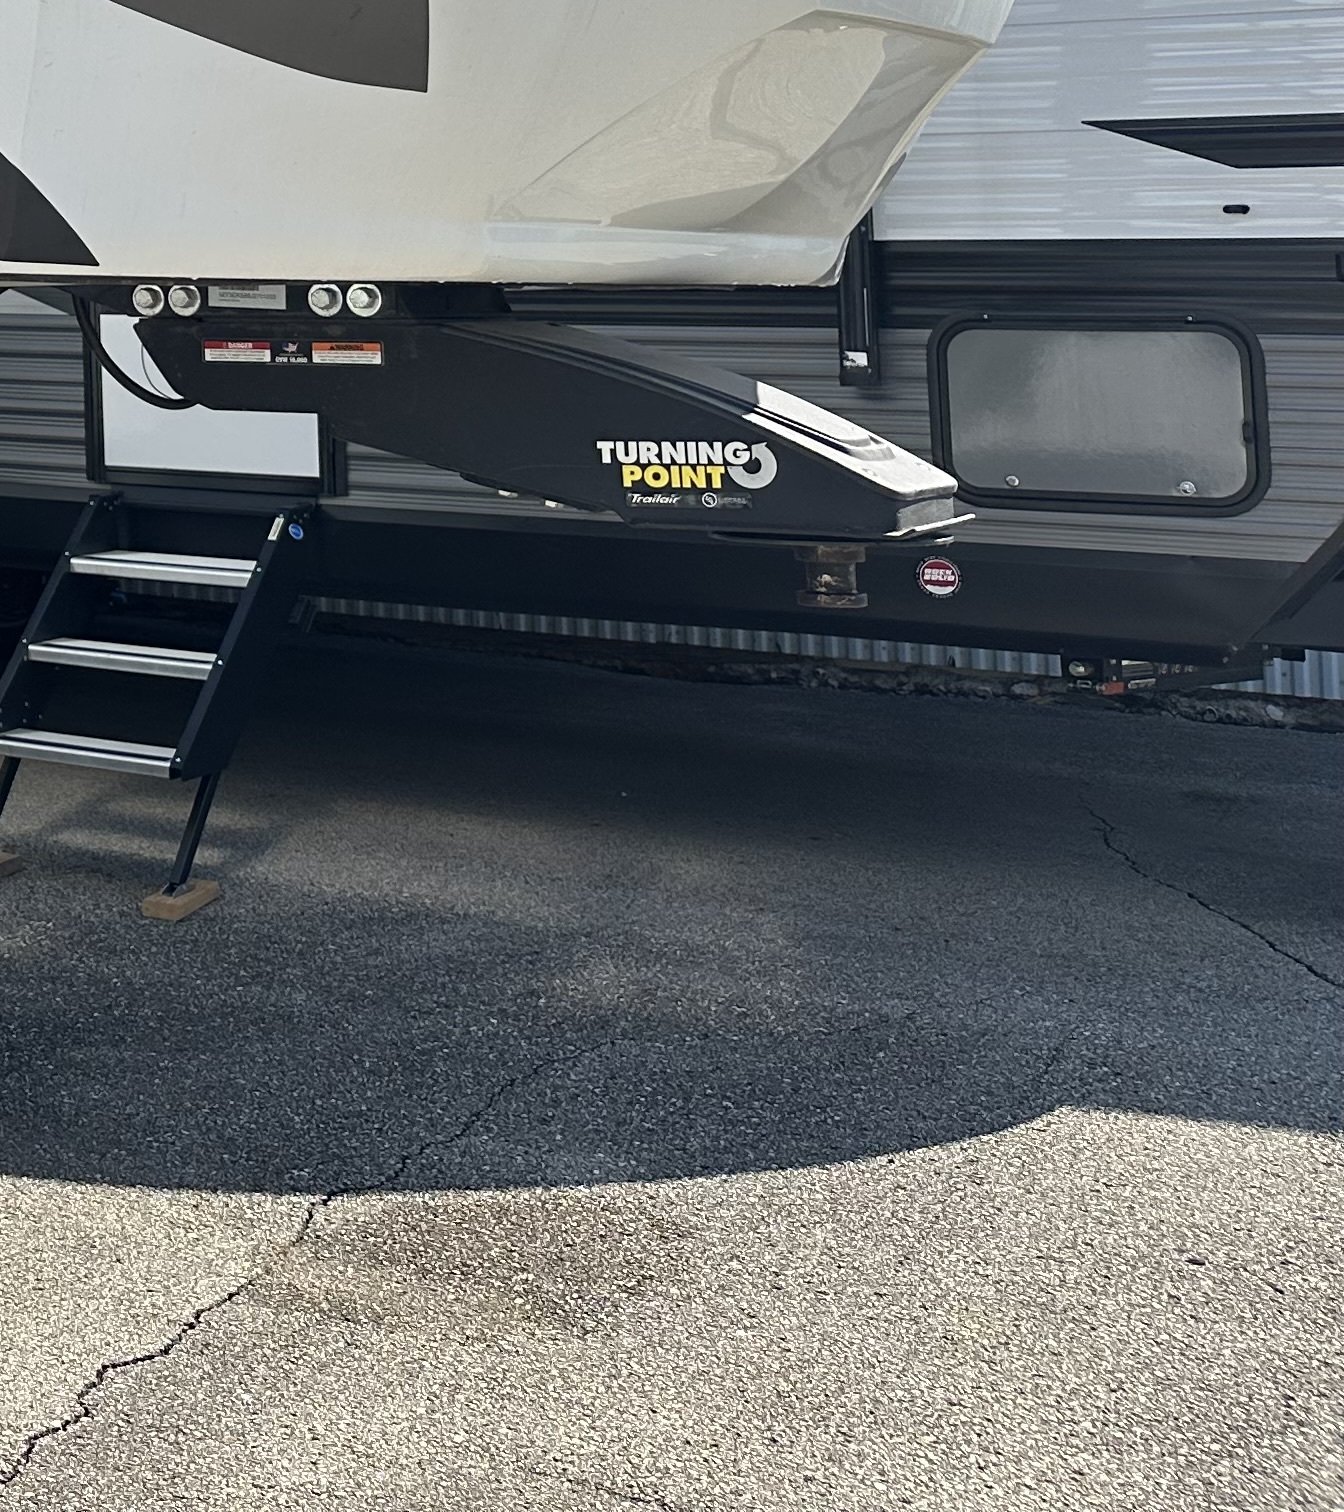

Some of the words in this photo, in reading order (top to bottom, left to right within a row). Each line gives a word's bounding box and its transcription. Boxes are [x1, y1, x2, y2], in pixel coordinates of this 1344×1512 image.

[596, 440, 751, 465] TURNING
[622, 465, 725, 488] POINT
[630, 493, 682, 504] Trailair
